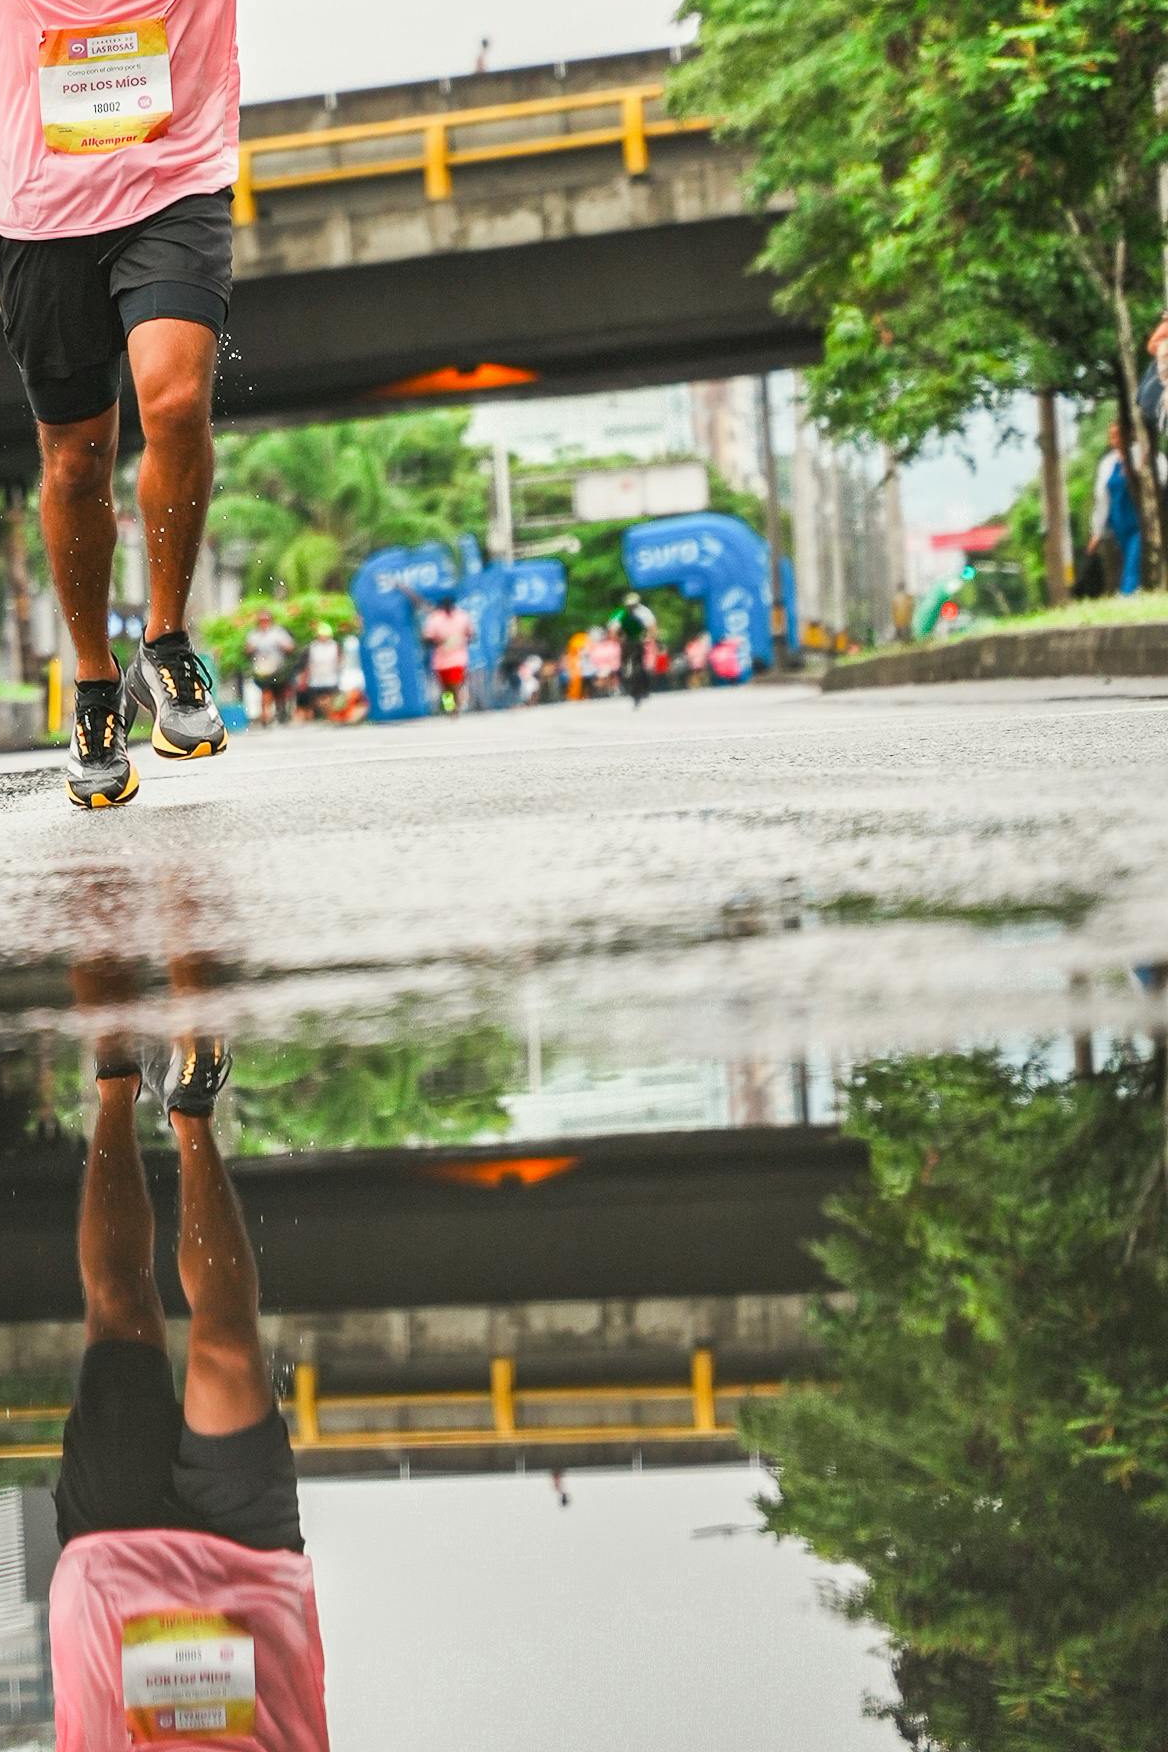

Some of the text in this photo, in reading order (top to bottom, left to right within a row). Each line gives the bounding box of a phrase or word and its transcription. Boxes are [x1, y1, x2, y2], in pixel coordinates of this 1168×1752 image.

[63, 76, 147, 94] POR LOS MÍOS
[93, 101, 121, 114] 18002
[80, 134, 138, 148] Alkomprar
[636, 538, 699, 572] sura
